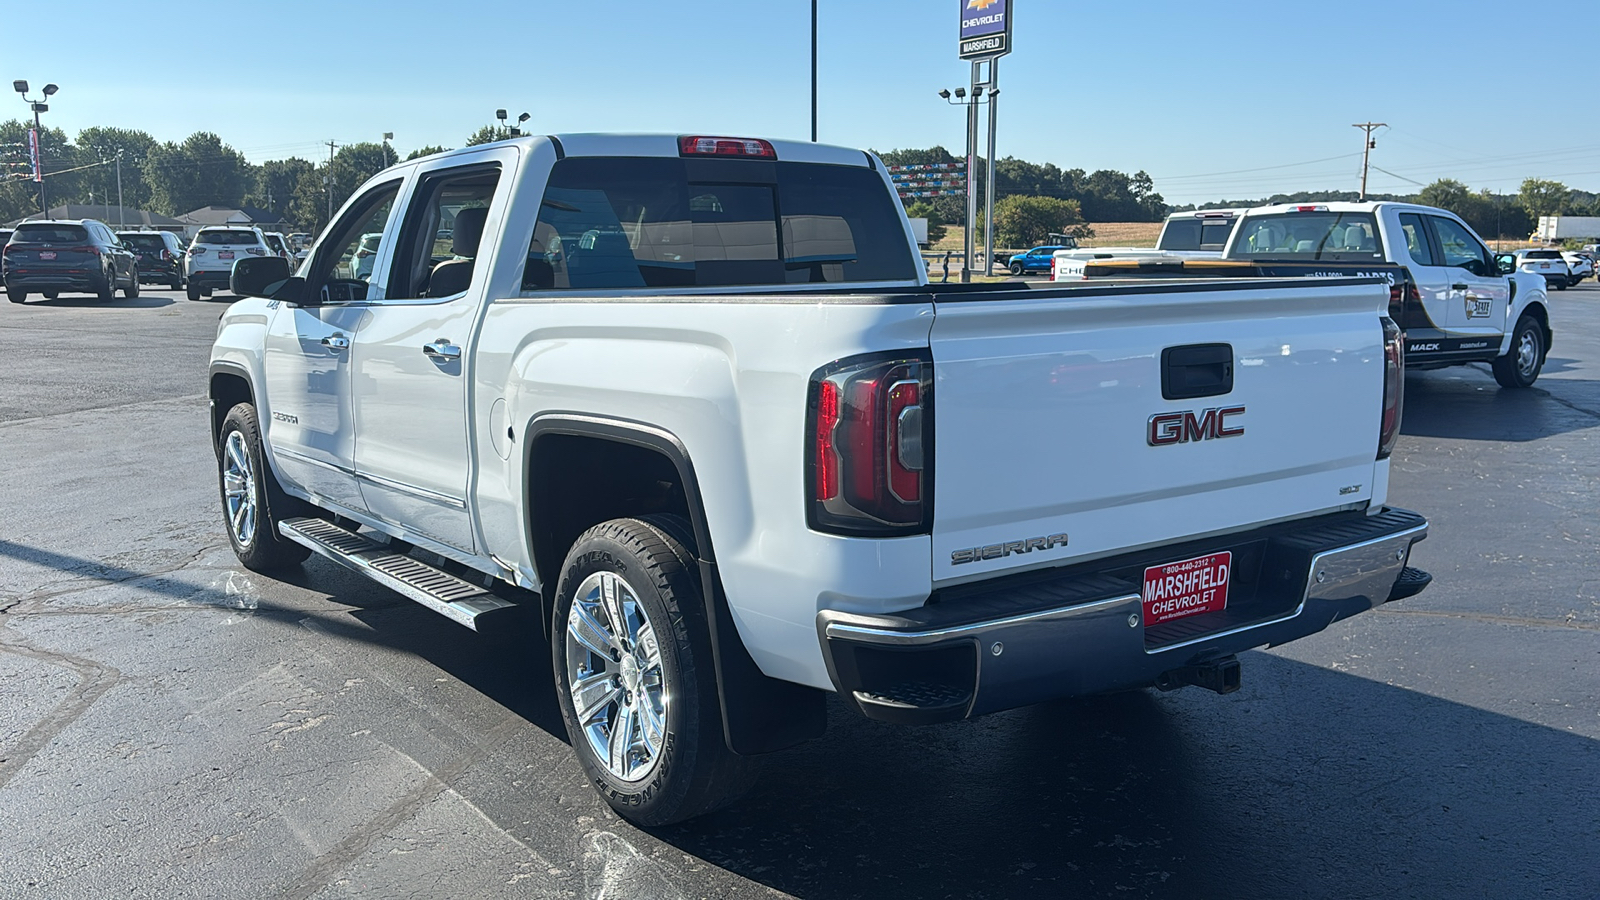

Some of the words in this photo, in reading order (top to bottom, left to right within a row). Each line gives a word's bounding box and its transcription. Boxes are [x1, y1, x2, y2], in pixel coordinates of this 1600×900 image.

[962, 13, 1004, 28] CHEVROLET
[963, 38, 999, 52] MARSHFIELD
[1410, 343, 1439, 351] MACK
[1147, 404, 1245, 446] GMC
[951, 533, 1069, 565] SIERRA
[1166, 558, 1209, 574] 800-440-2312
[1144, 564, 1228, 603] MARSHFIELD
[1151, 589, 1216, 615] CHEVROLET
[595, 730, 676, 807] WRANGLER
